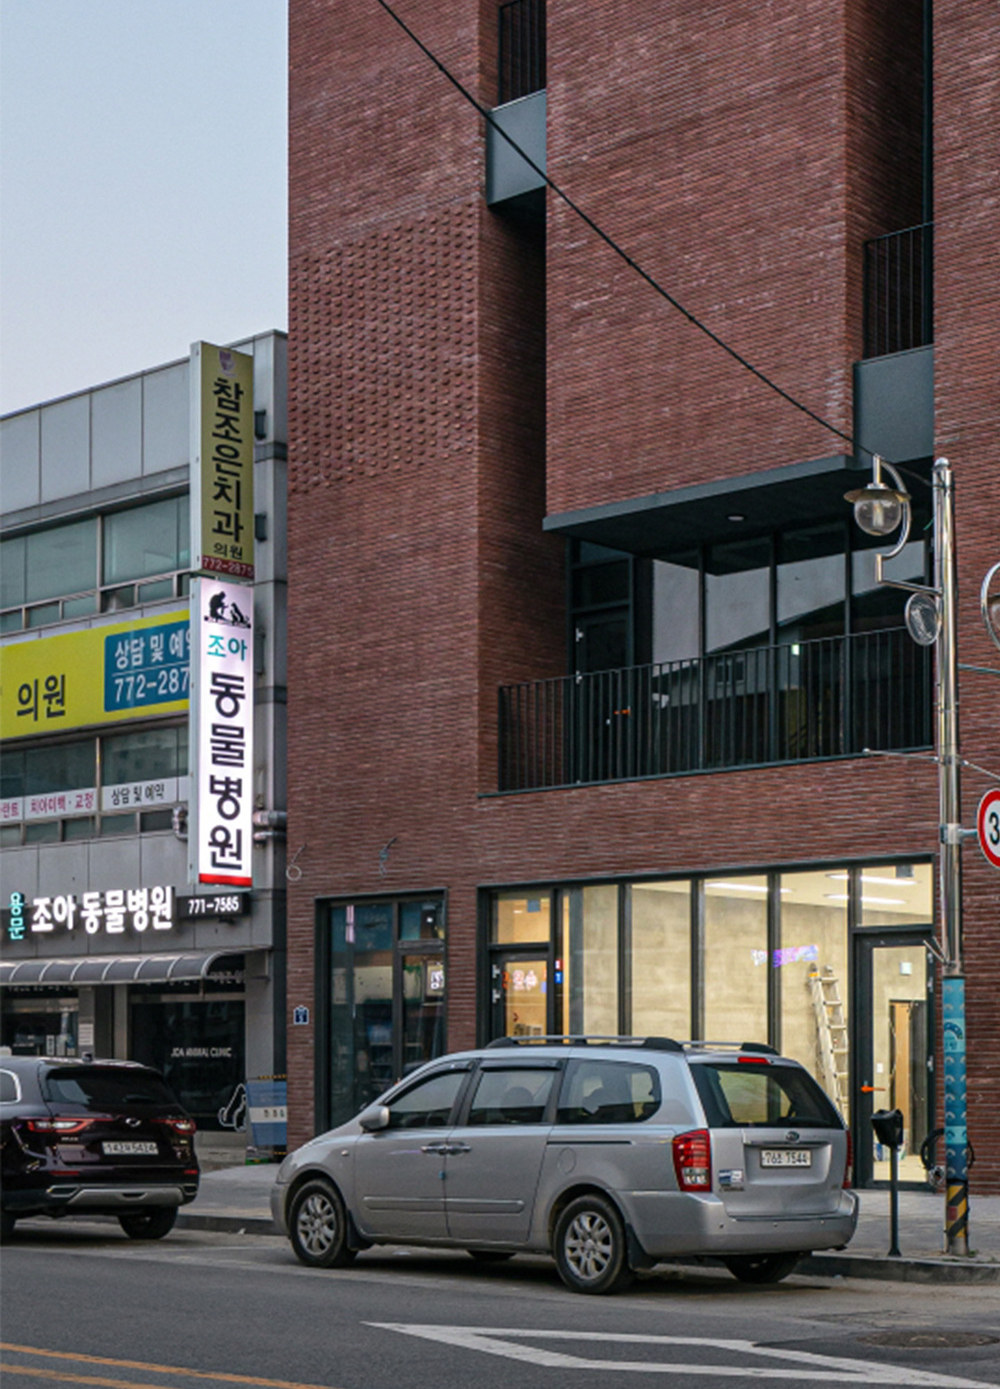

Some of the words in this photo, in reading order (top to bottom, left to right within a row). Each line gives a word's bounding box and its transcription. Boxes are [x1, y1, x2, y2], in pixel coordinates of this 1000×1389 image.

[212, 377, 244, 543] 참조은치과
[213, 543, 243, 560] 의원
[115, 638, 145, 669] 상담
[151, 633, 165, 663] 및
[207, 634, 248, 662] 조아
[17, 674, 65, 722] 의원
[208, 672, 246, 871] 동물병원
[111, 787, 130, 806] 상담
[133, 785, 142, 804] 및
[145, 783, 165, 801] 예약
[8, 892, 25, 940] 용문
[31, 894, 76, 932] 조아
[81, 886, 173, 934] 동물병원
[188, 896, 239, 914] 771-7585
